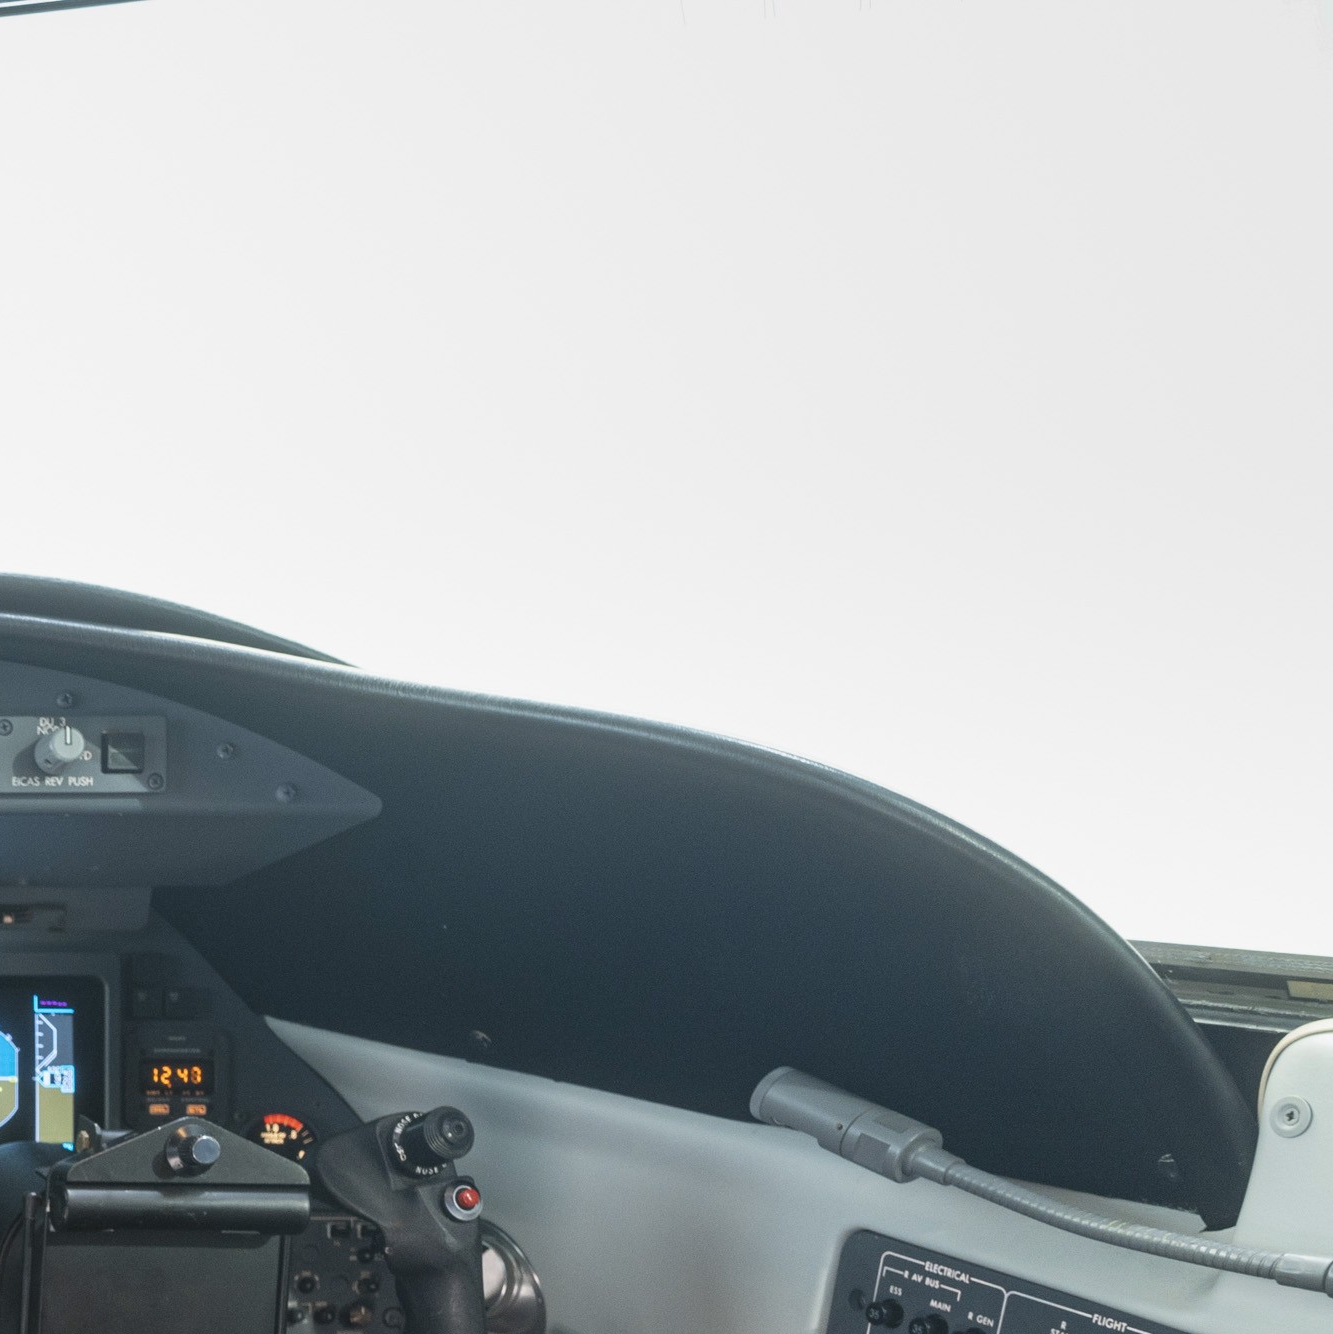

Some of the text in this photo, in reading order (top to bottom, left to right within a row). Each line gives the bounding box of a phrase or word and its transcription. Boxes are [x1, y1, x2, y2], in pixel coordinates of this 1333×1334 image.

[12, 776, 94, 787] EICAS REV PUSH
[925, 1262, 970, 1284] ELECTRICAL
[1092, 1314, 1127, 1332] FLIGHT
